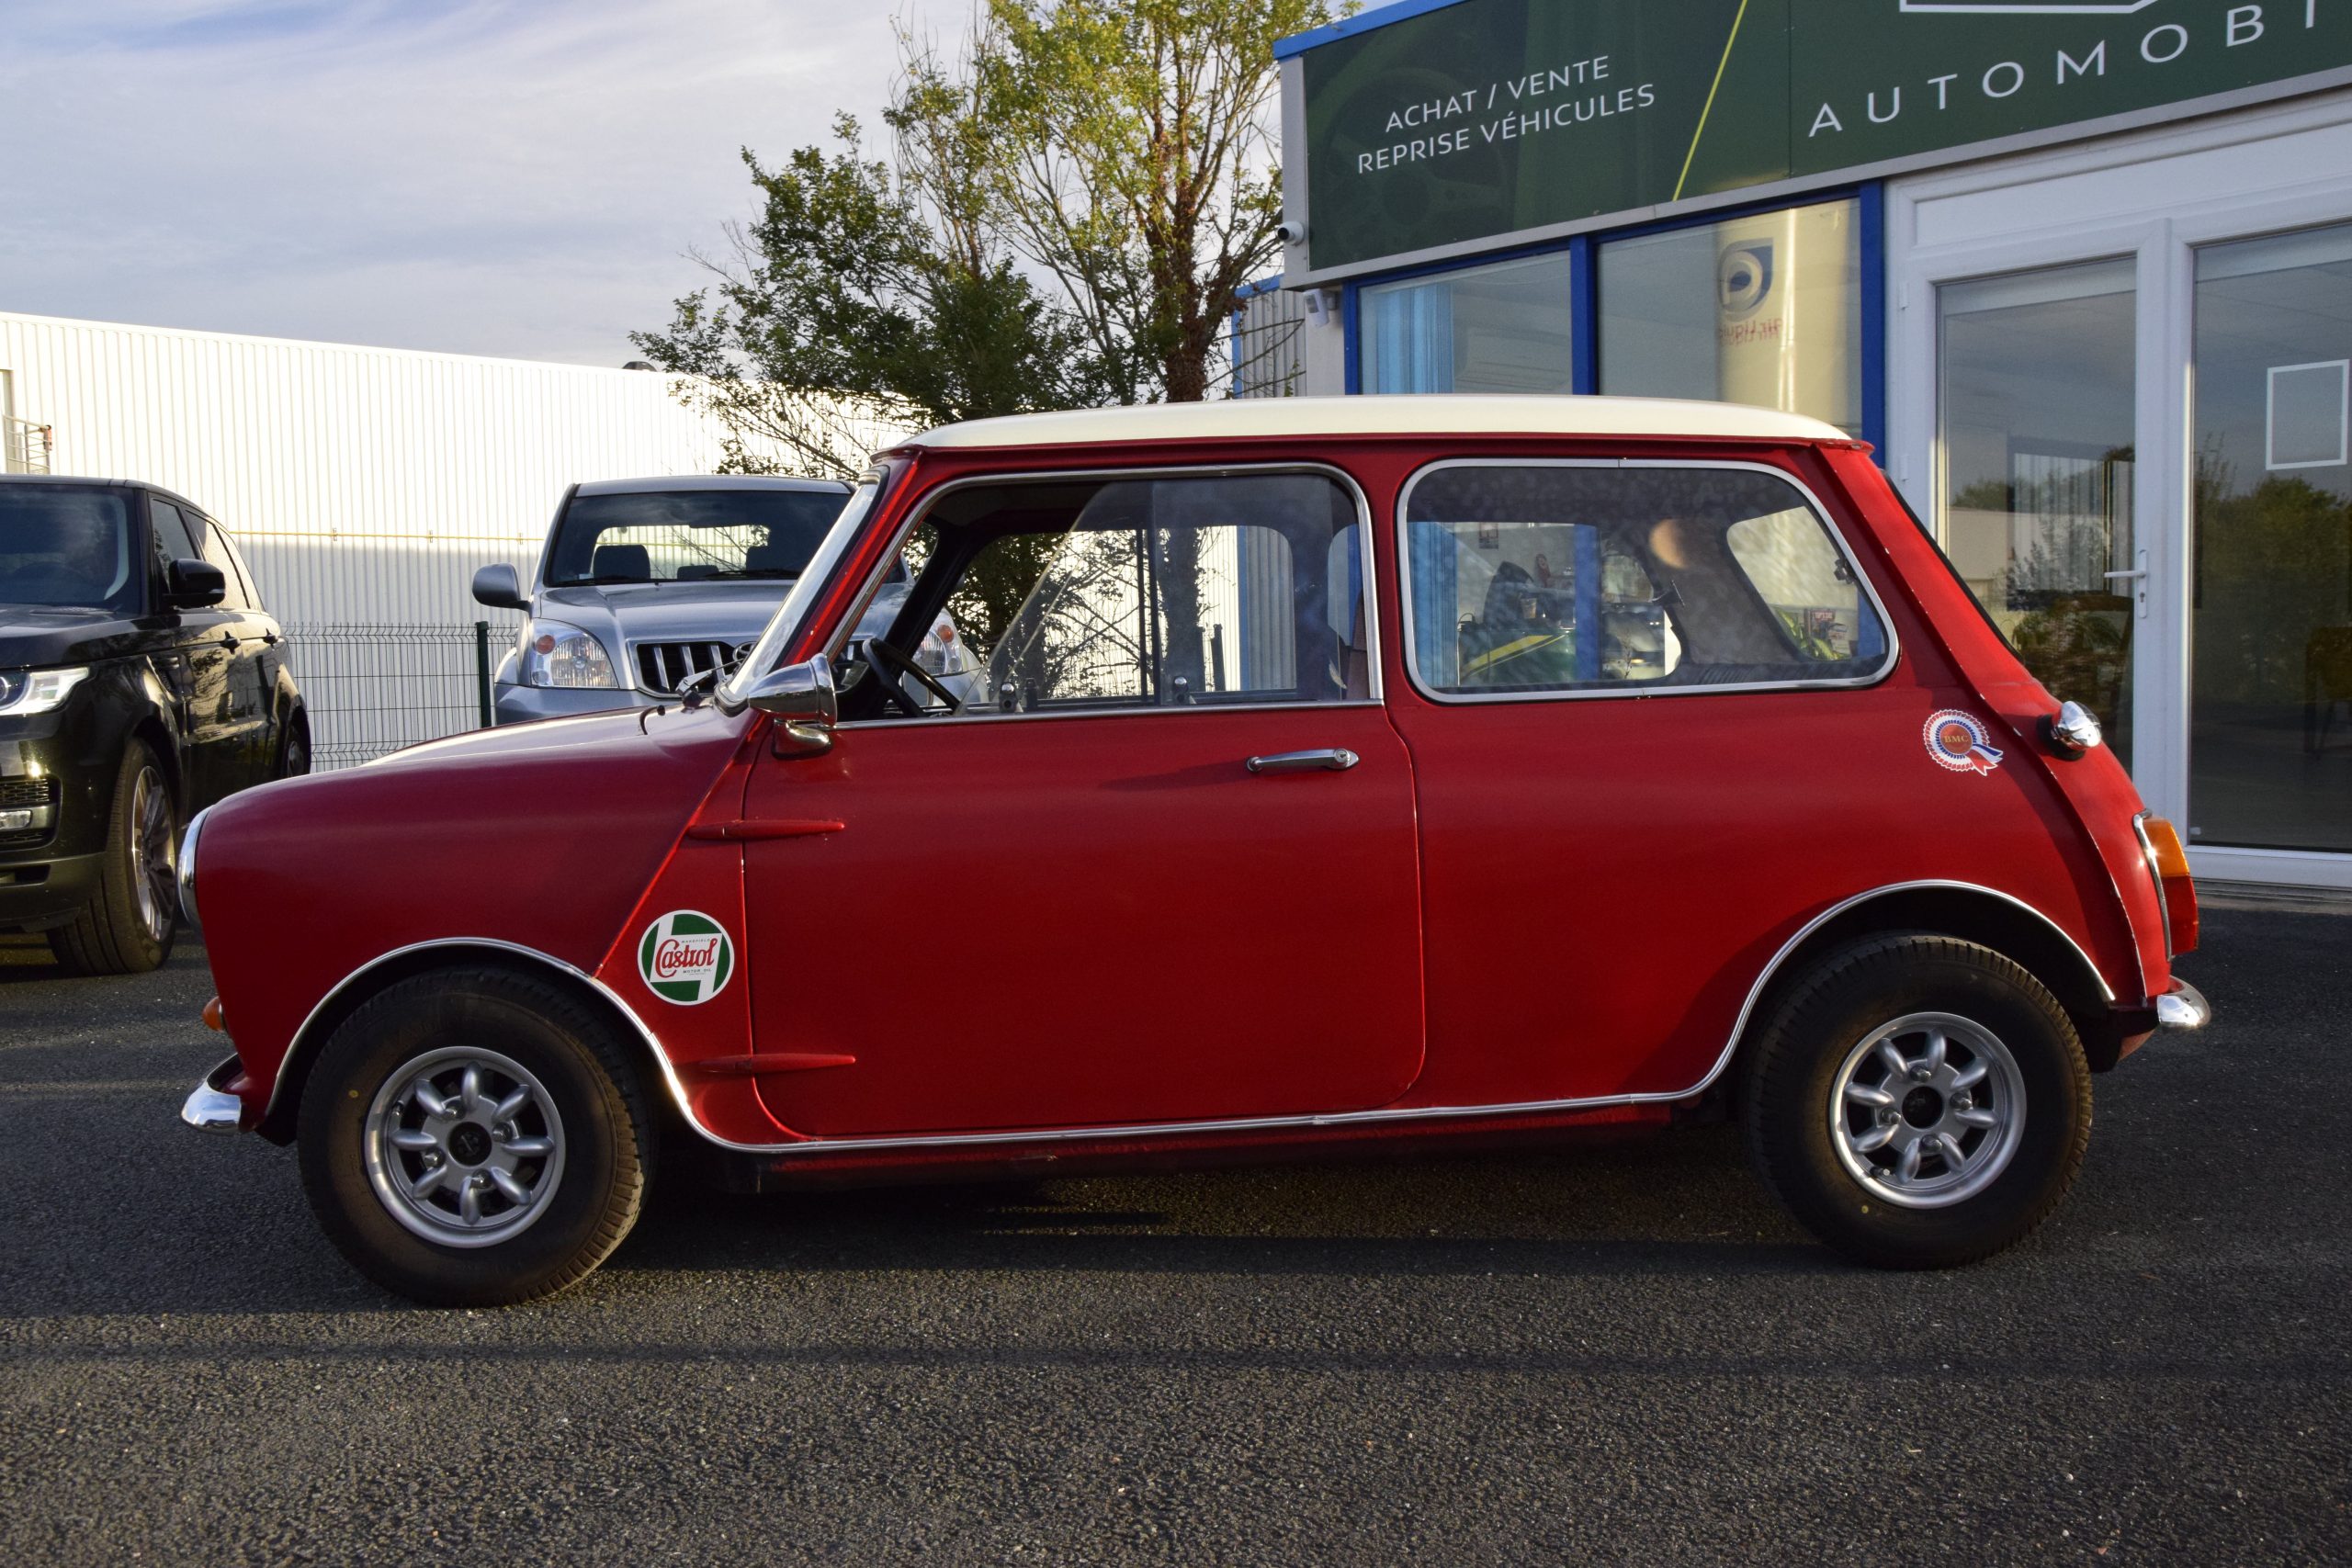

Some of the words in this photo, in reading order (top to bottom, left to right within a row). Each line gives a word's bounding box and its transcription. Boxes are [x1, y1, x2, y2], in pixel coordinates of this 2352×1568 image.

[1385, 89, 1477, 134] ACHAT
[1487, 84, 1498, 109] /
[1507, 55, 1609, 99] VENTE
[1358, 128, 1470, 174] REPRISE
[1479, 84, 1655, 143] VÉHICULES
[1944, 735, 1969, 743] BMC
[655, 937, 718, 978] Castrol
